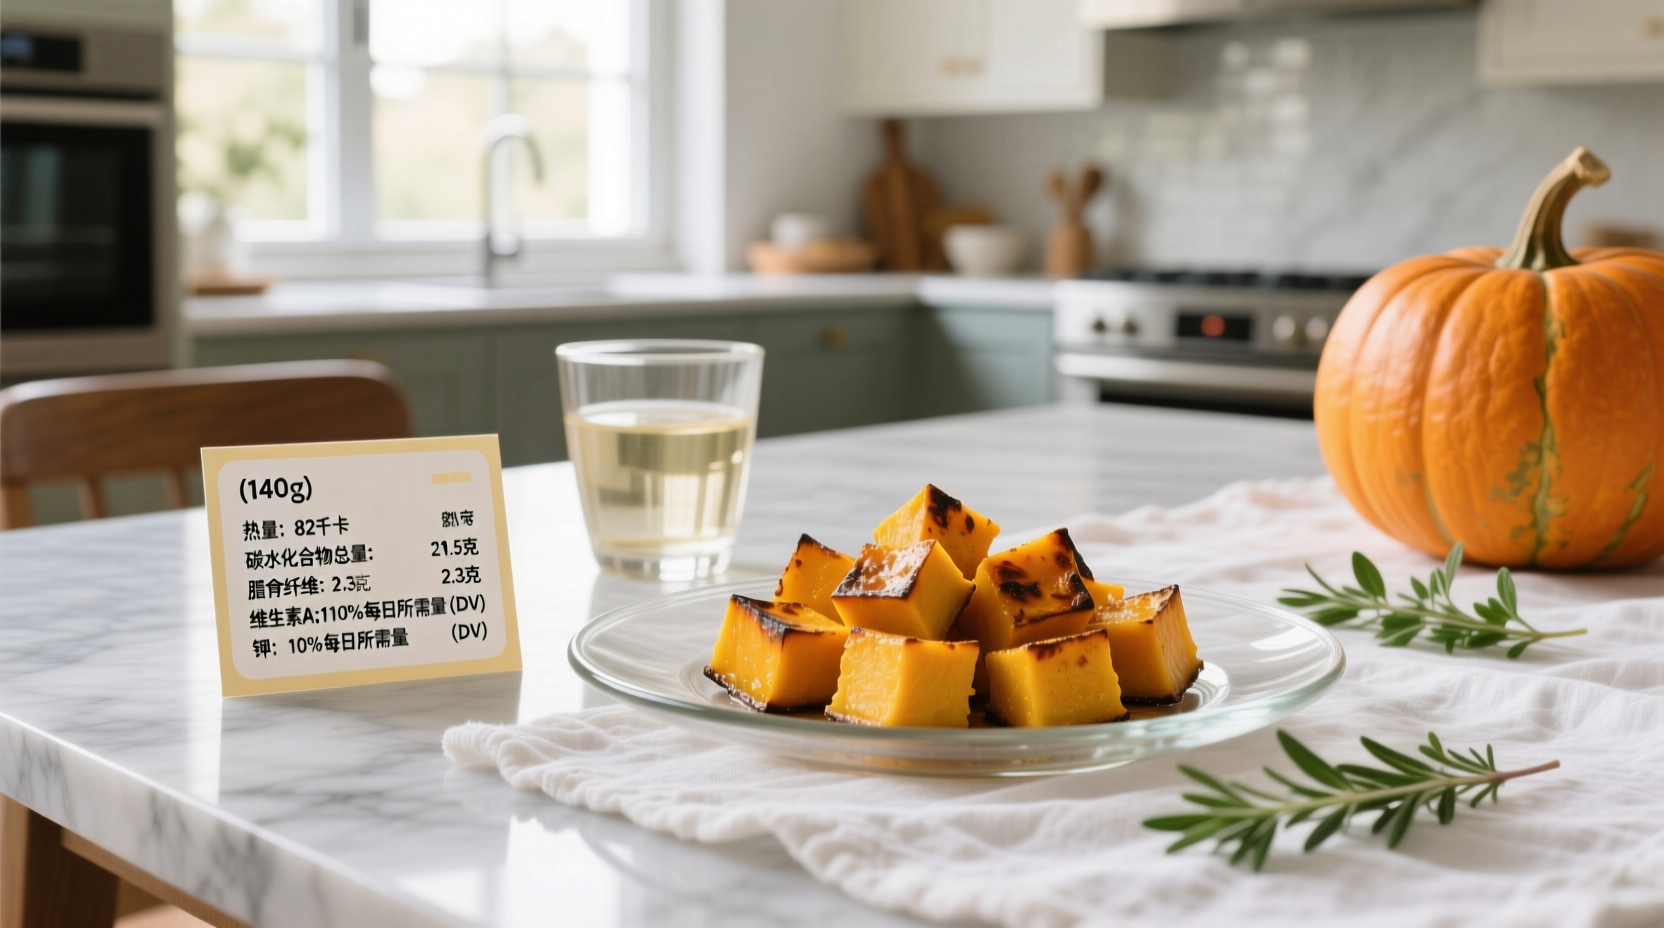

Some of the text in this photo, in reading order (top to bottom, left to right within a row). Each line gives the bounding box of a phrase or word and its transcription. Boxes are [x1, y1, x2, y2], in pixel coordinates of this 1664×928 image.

[239, 475, 313, 505] (140g)
[430, 537, 480, 557] 21.5克
[441, 564, 482, 585] 2.3克
[451, 620, 488, 644] (DV)
